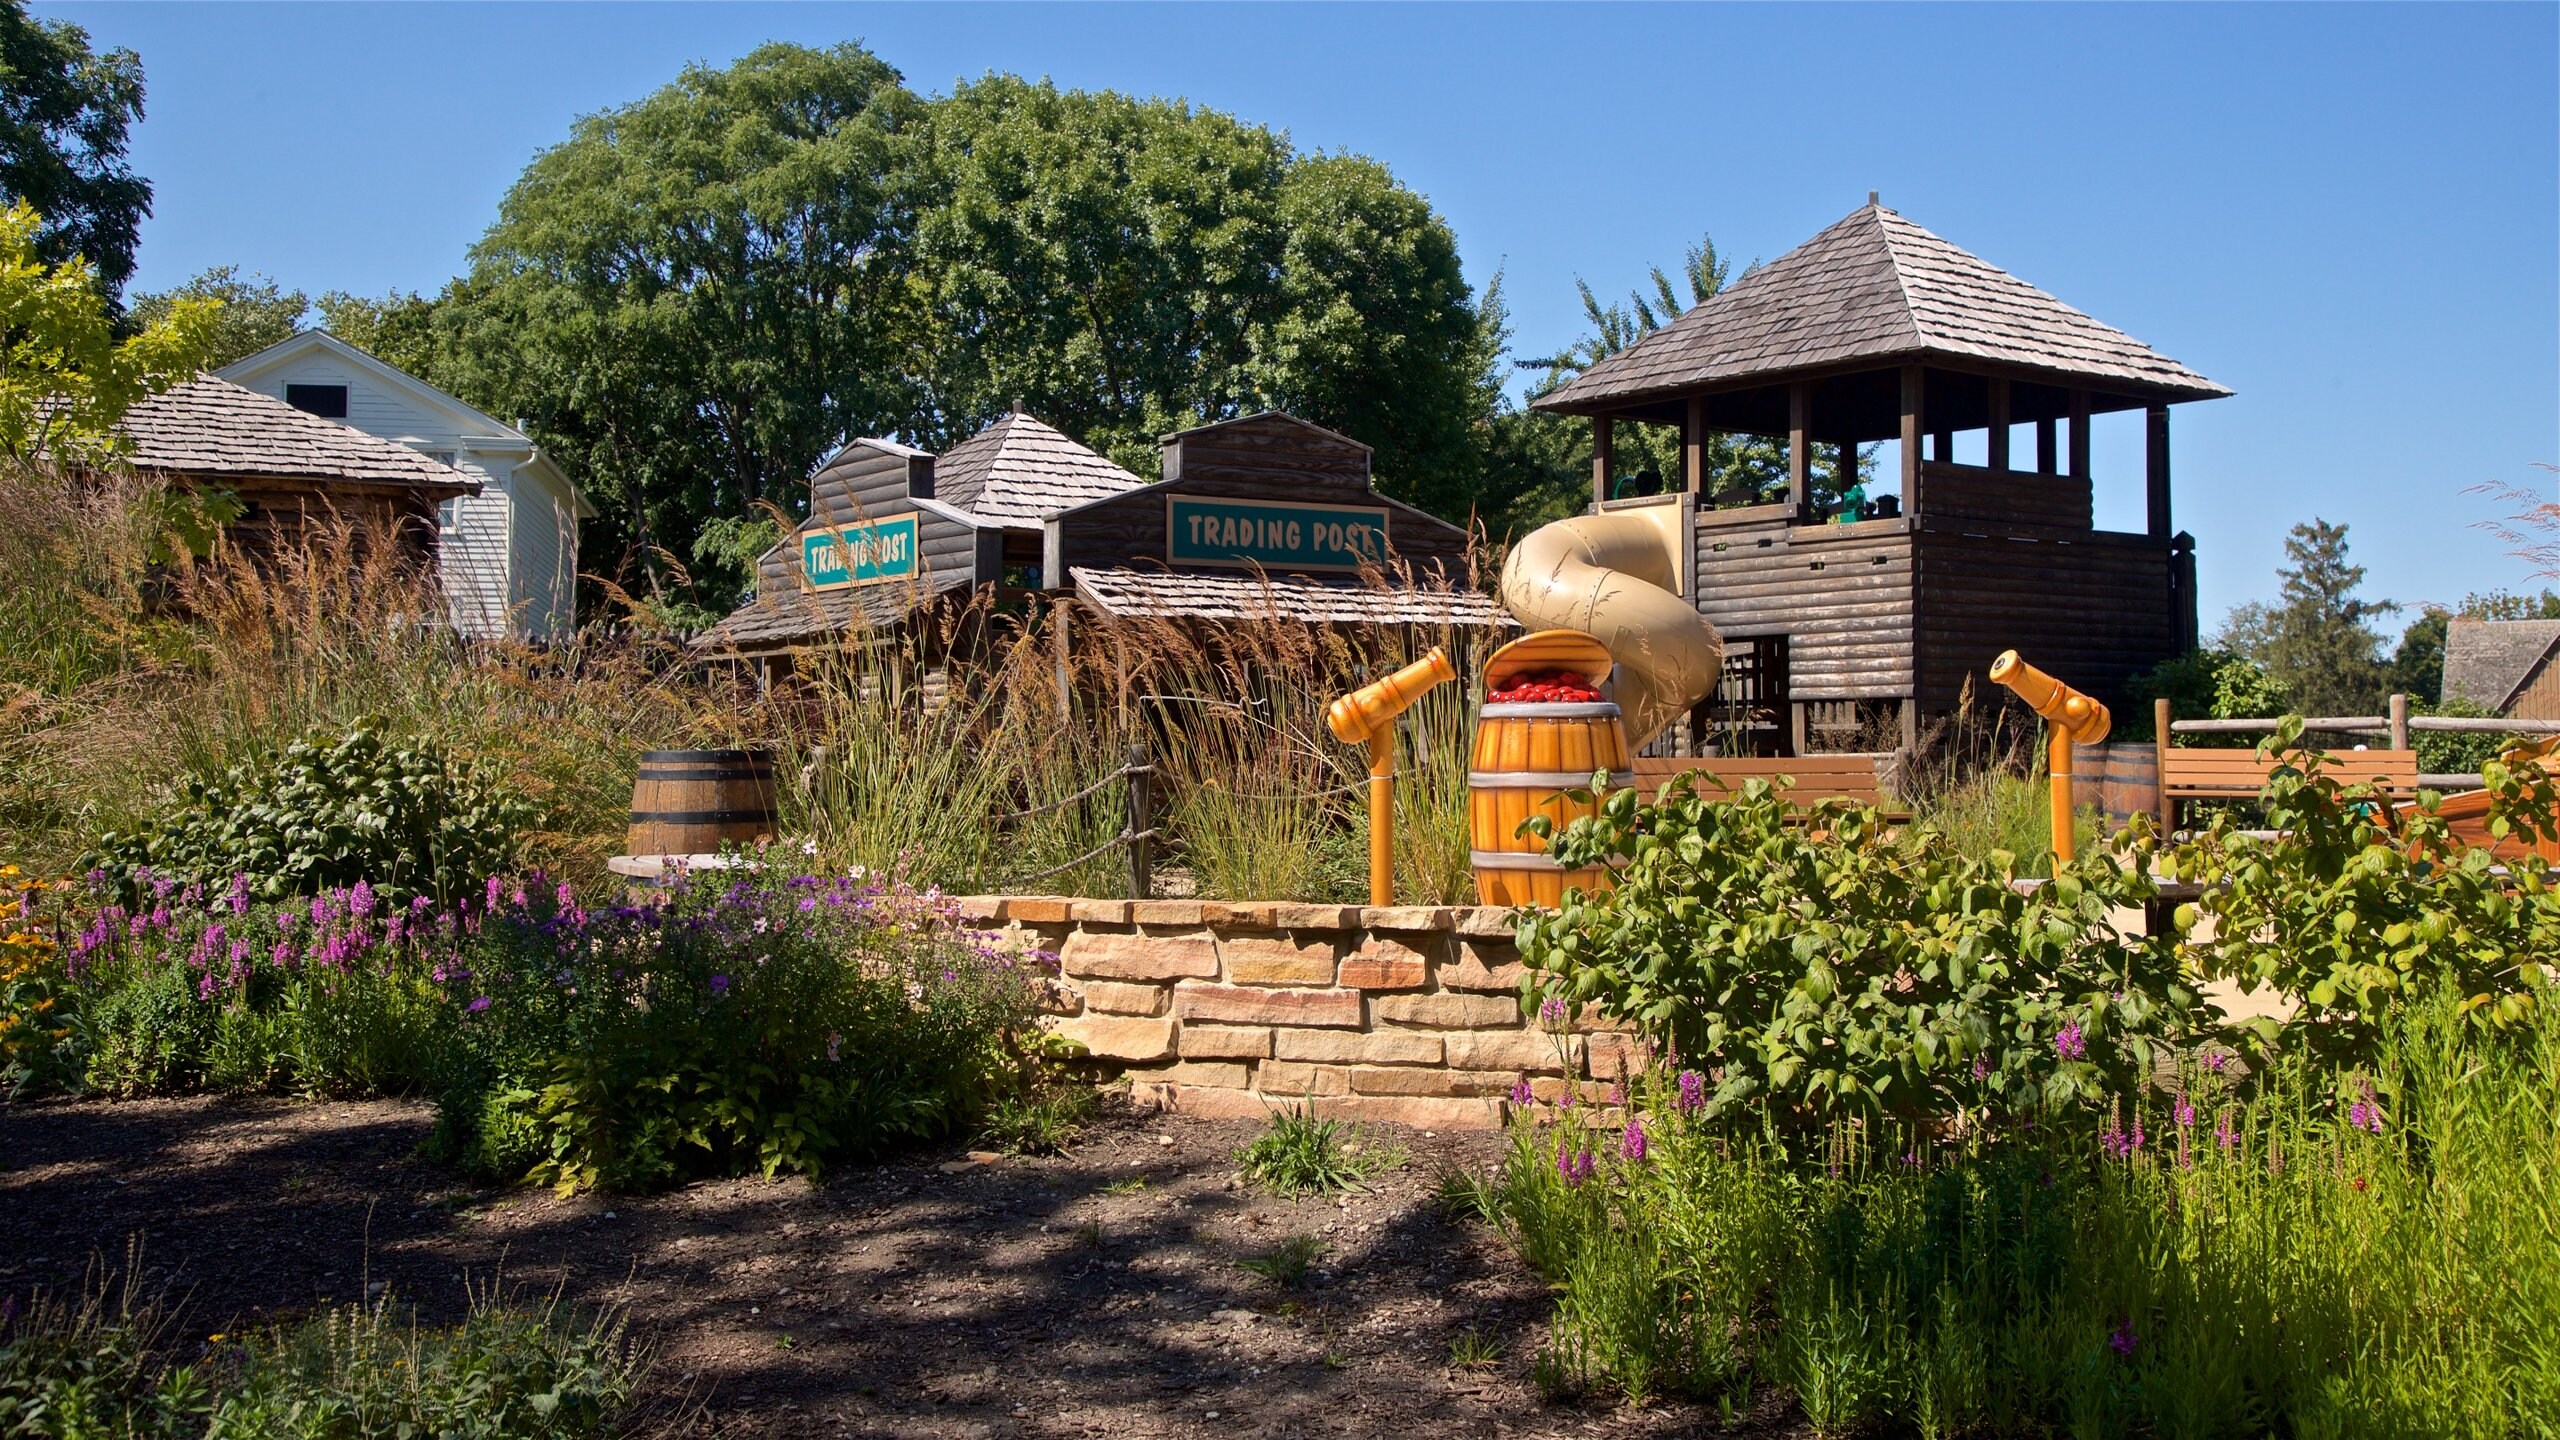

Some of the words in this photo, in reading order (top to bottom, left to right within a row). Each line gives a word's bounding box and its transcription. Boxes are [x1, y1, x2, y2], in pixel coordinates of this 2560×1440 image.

[811, 539, 868, 574] TRANG
[873, 532, 908, 564] OST
[1188, 515, 1301, 550] TRADING
[1313, 522, 1372, 553] POST
